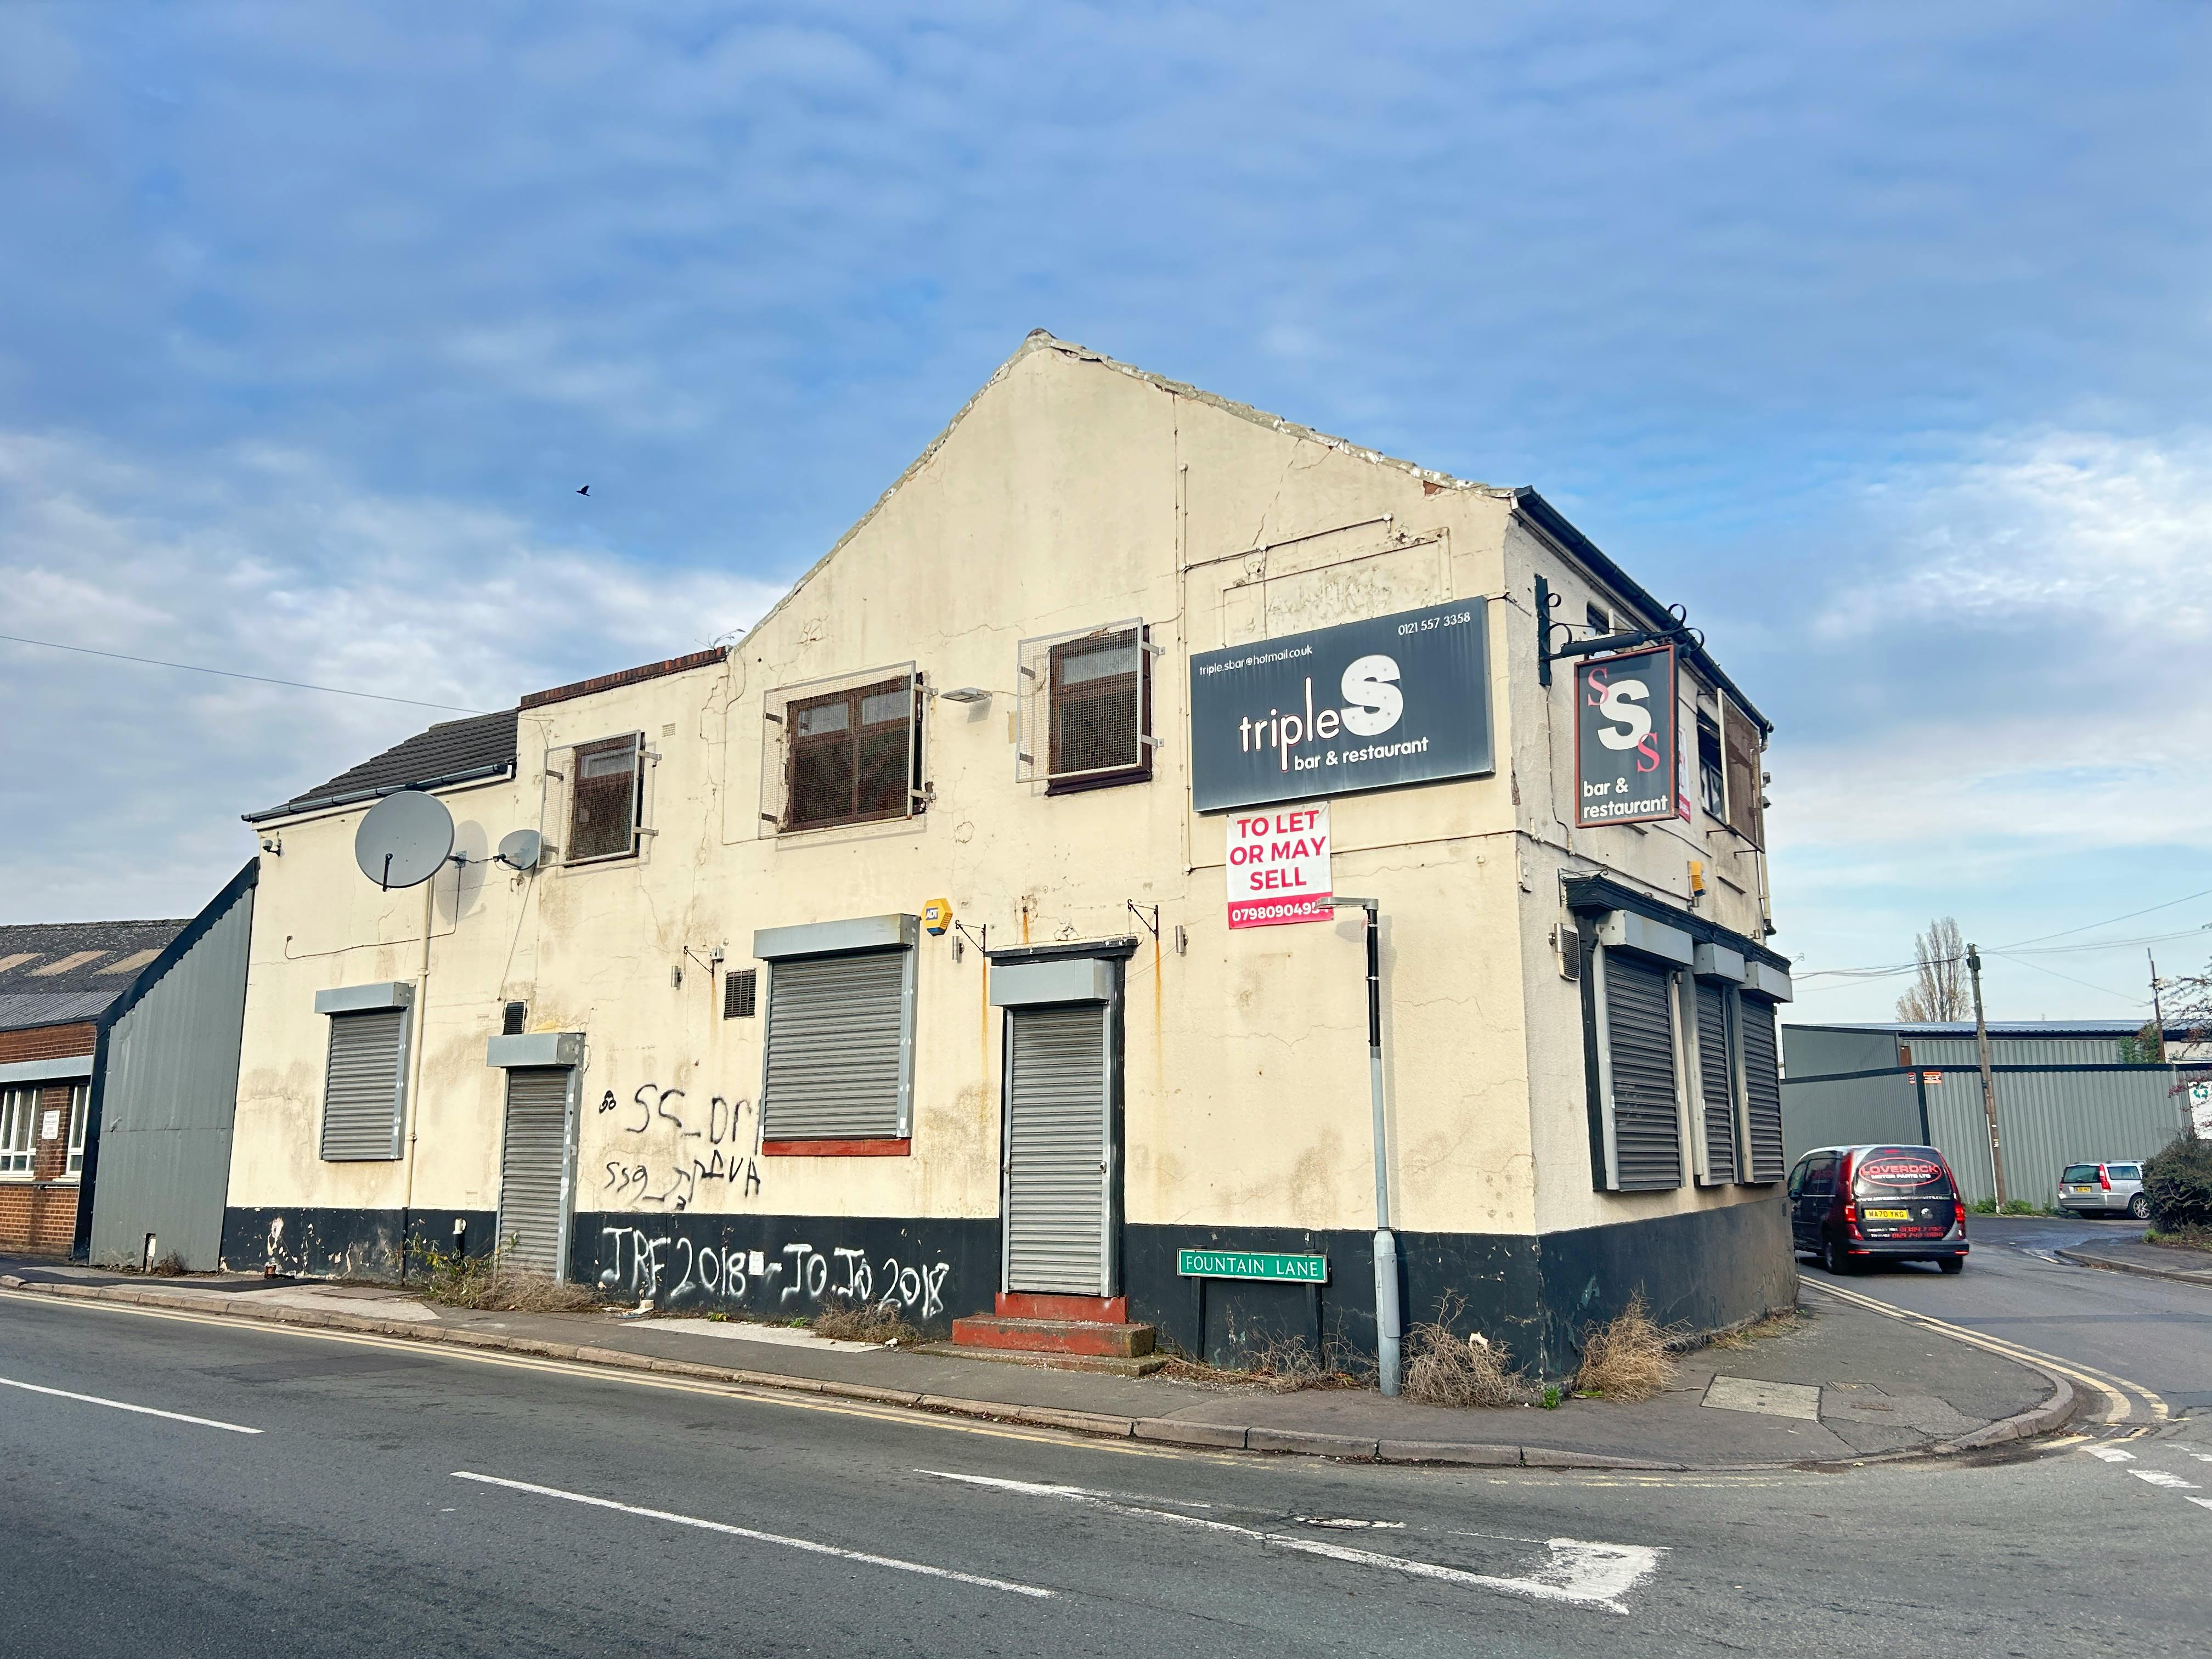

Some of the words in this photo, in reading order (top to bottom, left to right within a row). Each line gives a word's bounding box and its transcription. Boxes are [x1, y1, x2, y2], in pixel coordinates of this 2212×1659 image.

[1398, 622, 1418, 635] 0121
[1421, 617, 1440, 631] 557
[1443, 612, 1471, 627] 3358
[1199, 644, 1313, 676] triple.sbar@hotmail.co.uk
[1597, 680, 1652, 751] S
[1294, 754, 1319, 771] bar
[1325, 751, 1339, 766] &
[1342, 736, 1429, 764] restaurant
[1583, 781, 1611, 797] bar
[1615, 777, 1629, 794] &
[1583, 795, 1668, 819] restaurant
[1237, 817, 1269, 839] TO
[1276, 809, 1320, 834] LET
[1229, 844, 1264, 866] OR
[1271, 836, 1327, 861] MAY
[1249, 867, 1307, 891] SELL
[926, 909, 939, 919] ADT
[1186, 1255, 1264, 1273] FOUNTAIN
[1276, 1260, 1318, 1277] LANE
